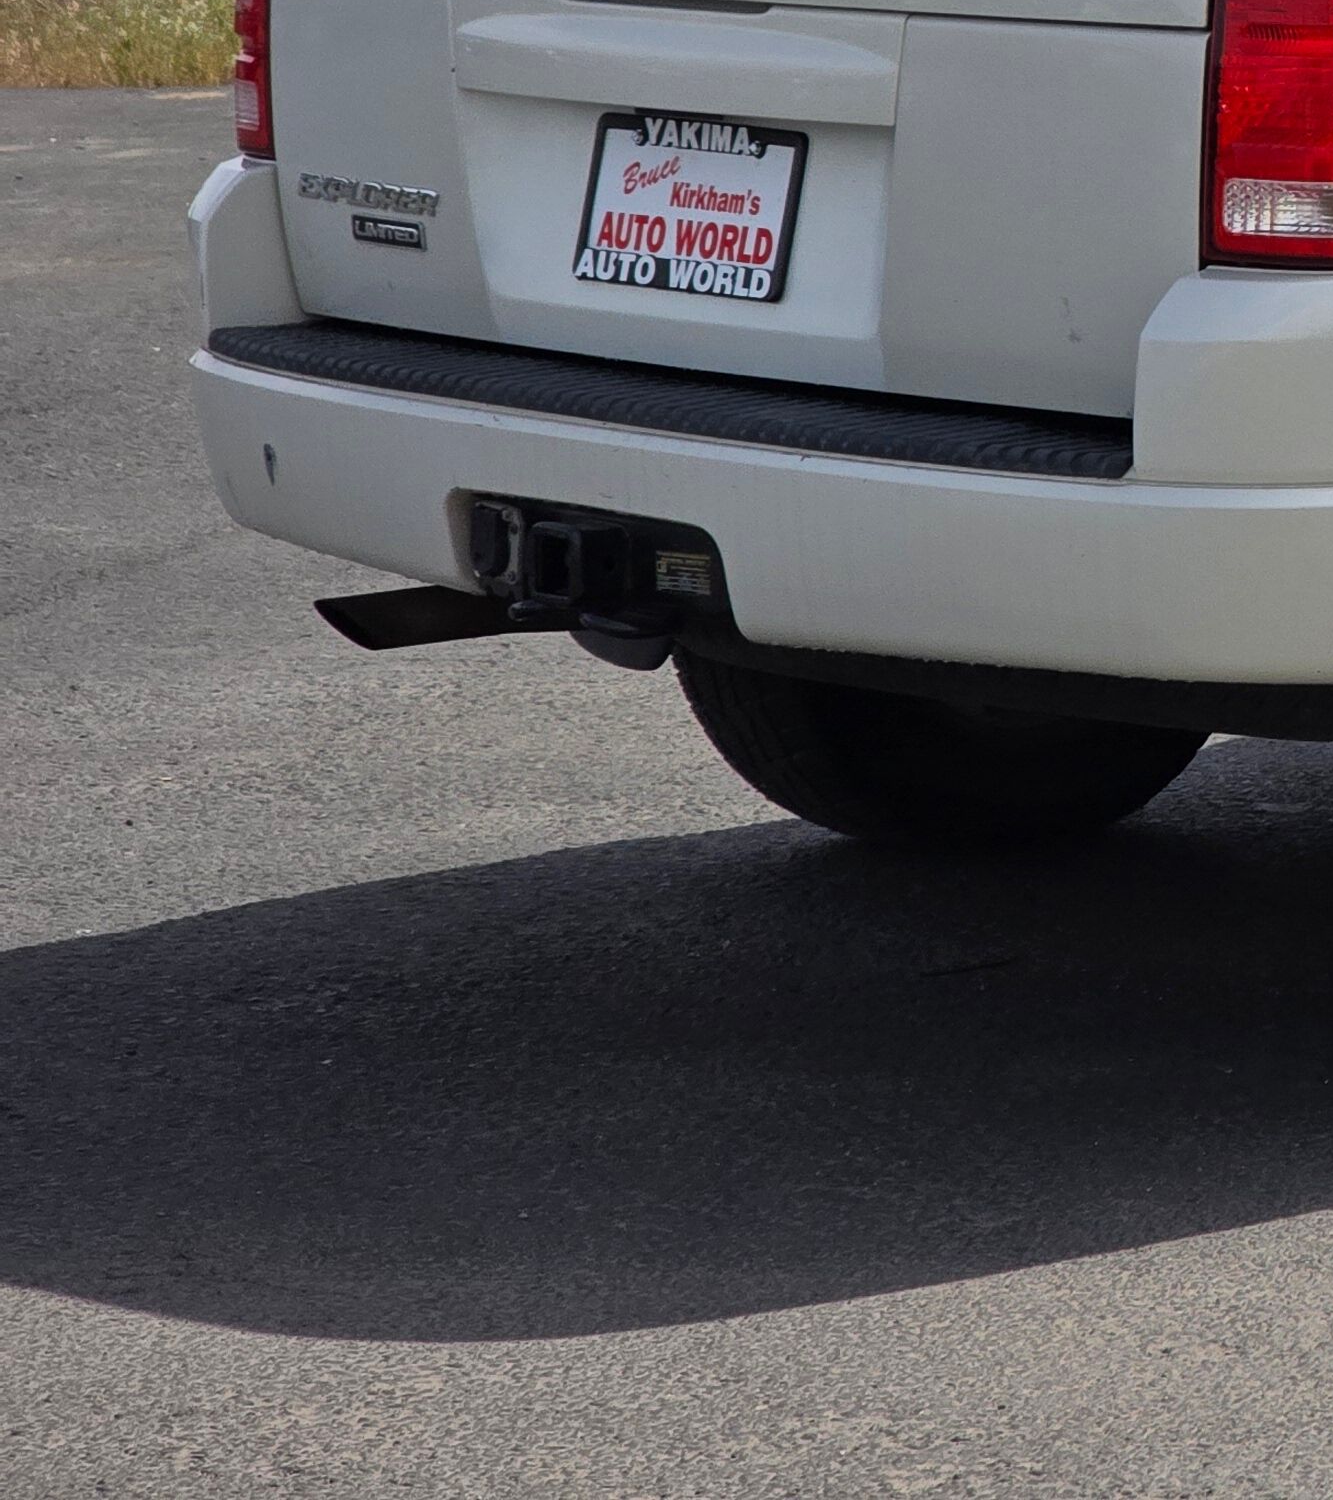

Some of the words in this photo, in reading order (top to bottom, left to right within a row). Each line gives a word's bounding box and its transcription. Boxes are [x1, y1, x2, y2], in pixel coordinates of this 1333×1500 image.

[645, 116, 752, 157] YAKIMA
[299, 171, 441, 217] EXPLORER
[622, 155, 682, 195] Bruce
[669, 181, 761, 215] Kirkham's
[596, 211, 667, 254] AUTO
[674, 218, 773, 265] WORLD
[574, 248, 656, 285] AUTO
[667, 257, 772, 299] WORLD
